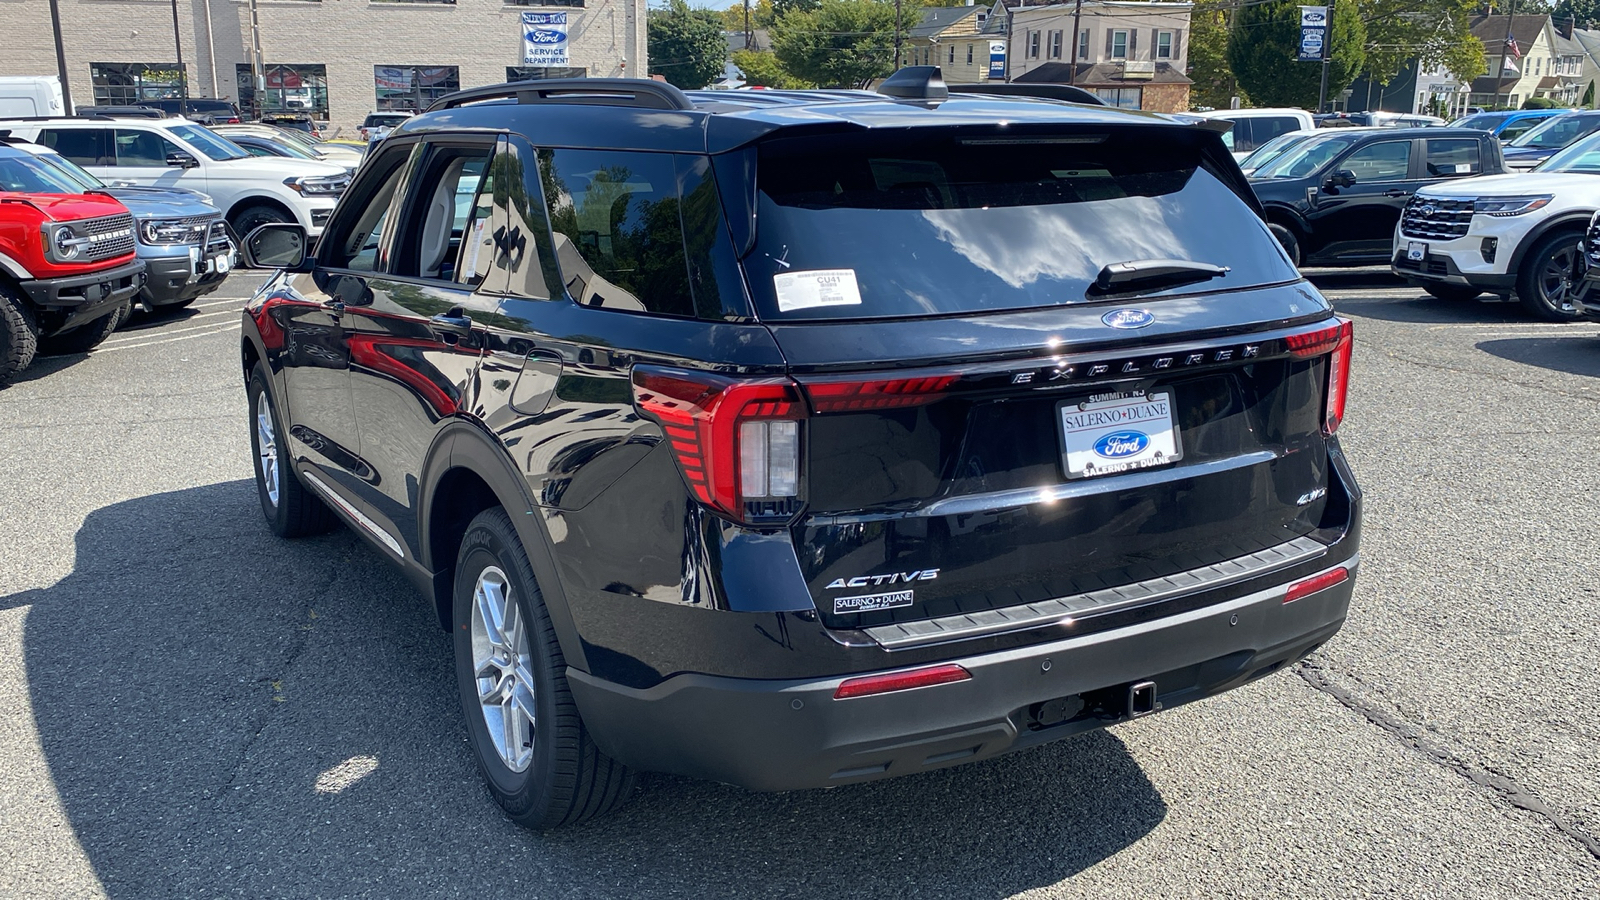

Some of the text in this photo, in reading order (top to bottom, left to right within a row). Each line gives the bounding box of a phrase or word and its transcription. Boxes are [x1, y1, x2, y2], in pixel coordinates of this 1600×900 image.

[532, 31, 559, 43] Ford
[89, 229, 131, 242] BRONCO
[816, 276, 841, 284] CU41
[1011, 346, 1260, 384] EXPLORER
[1089, 389, 1145, 403] SUMMIT, NJ
[1065, 402, 1168, 429] SALERNO DUANE
[1104, 434, 1140, 456] Ford
[1083, 455, 1171, 477] SALERNO DUANE
[824, 568, 940, 589] ACTIVE
[836, 592, 911, 608] SALERNO DUANE
